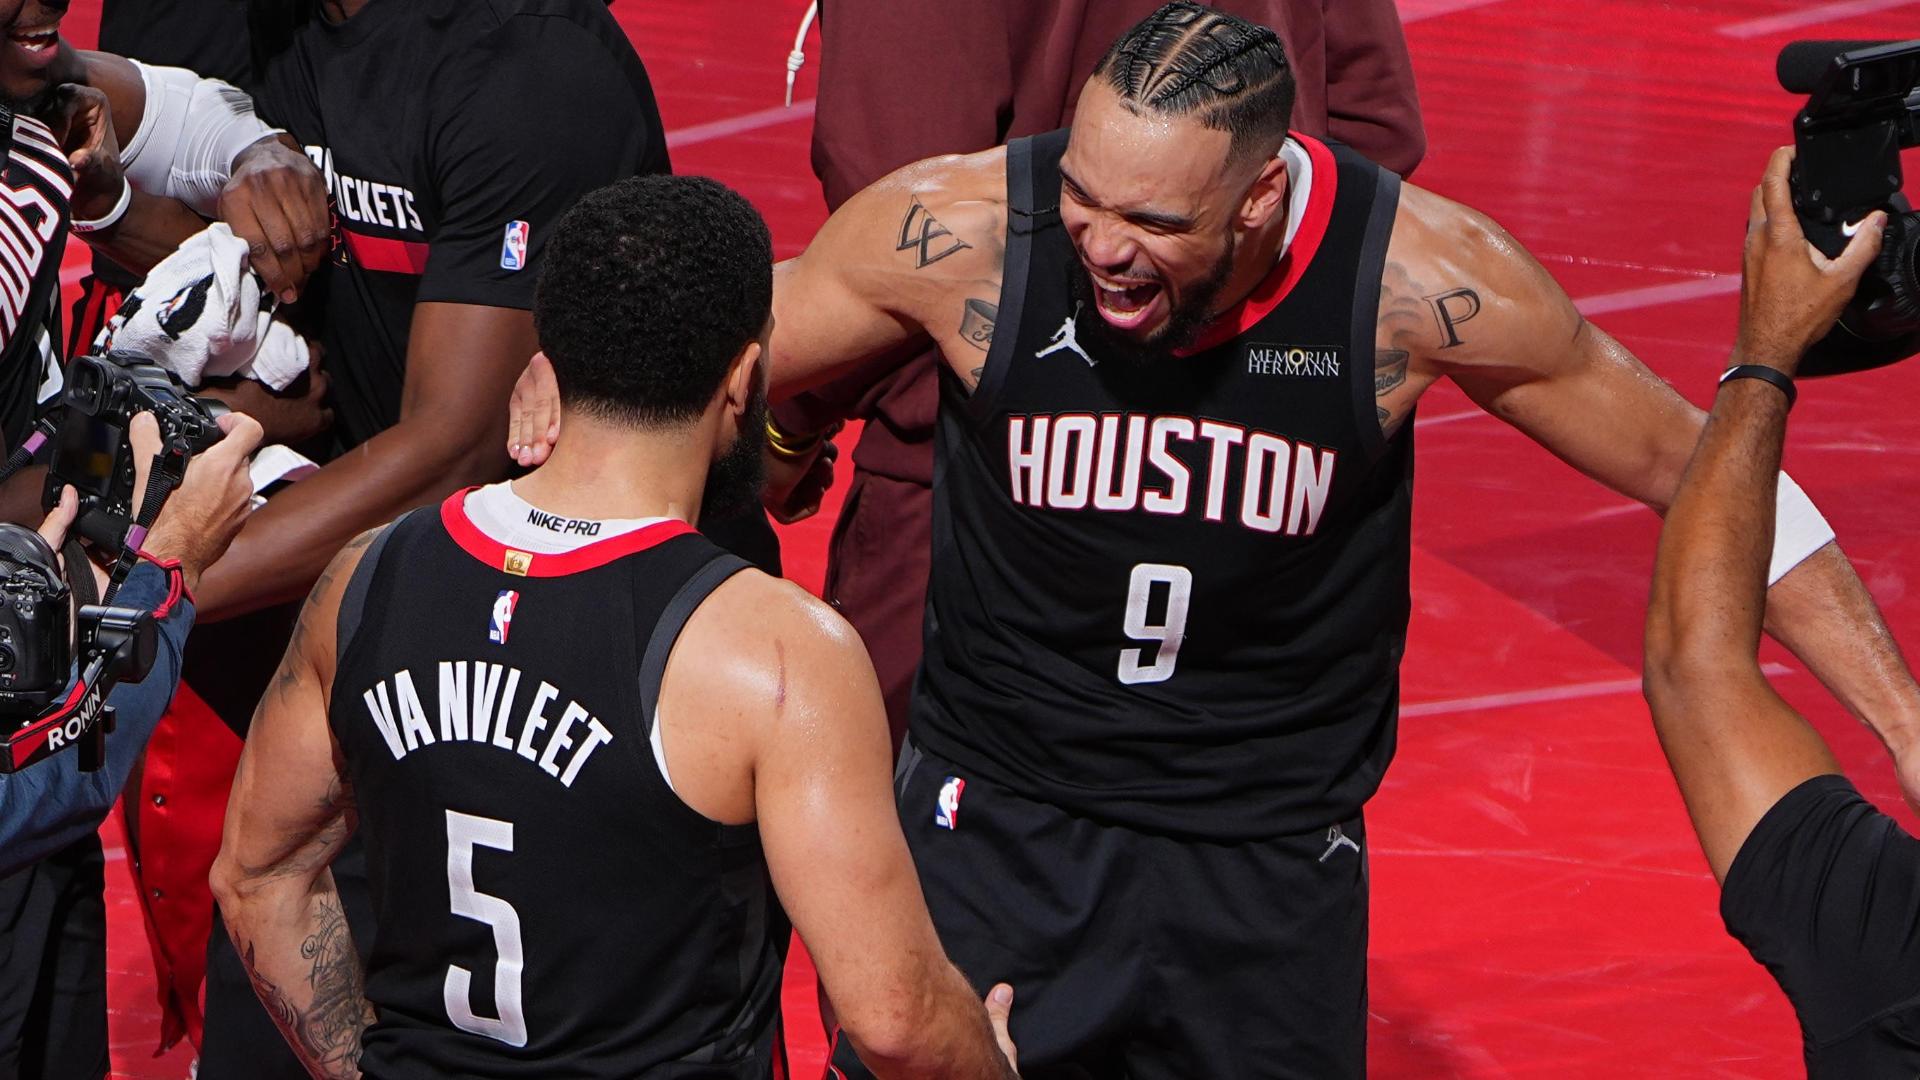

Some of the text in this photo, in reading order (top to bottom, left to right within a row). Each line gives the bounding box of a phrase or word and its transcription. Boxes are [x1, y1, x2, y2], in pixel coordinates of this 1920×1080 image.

[333, 171, 424, 231] OCKETS
[1422, 287, 1481, 350] P
[1248, 359, 1339, 377] HERMANN
[1249, 348, 1341, 366] MEMORIAL
[1006, 412, 1337, 537] HOUSTON
[527, 508, 602, 536] NIKE PRO
[1117, 563, 1193, 685] 9
[48, 683, 101, 751] RONIN
[363, 660, 613, 788] VANVLEET
[443, 809, 528, 1048] 5
